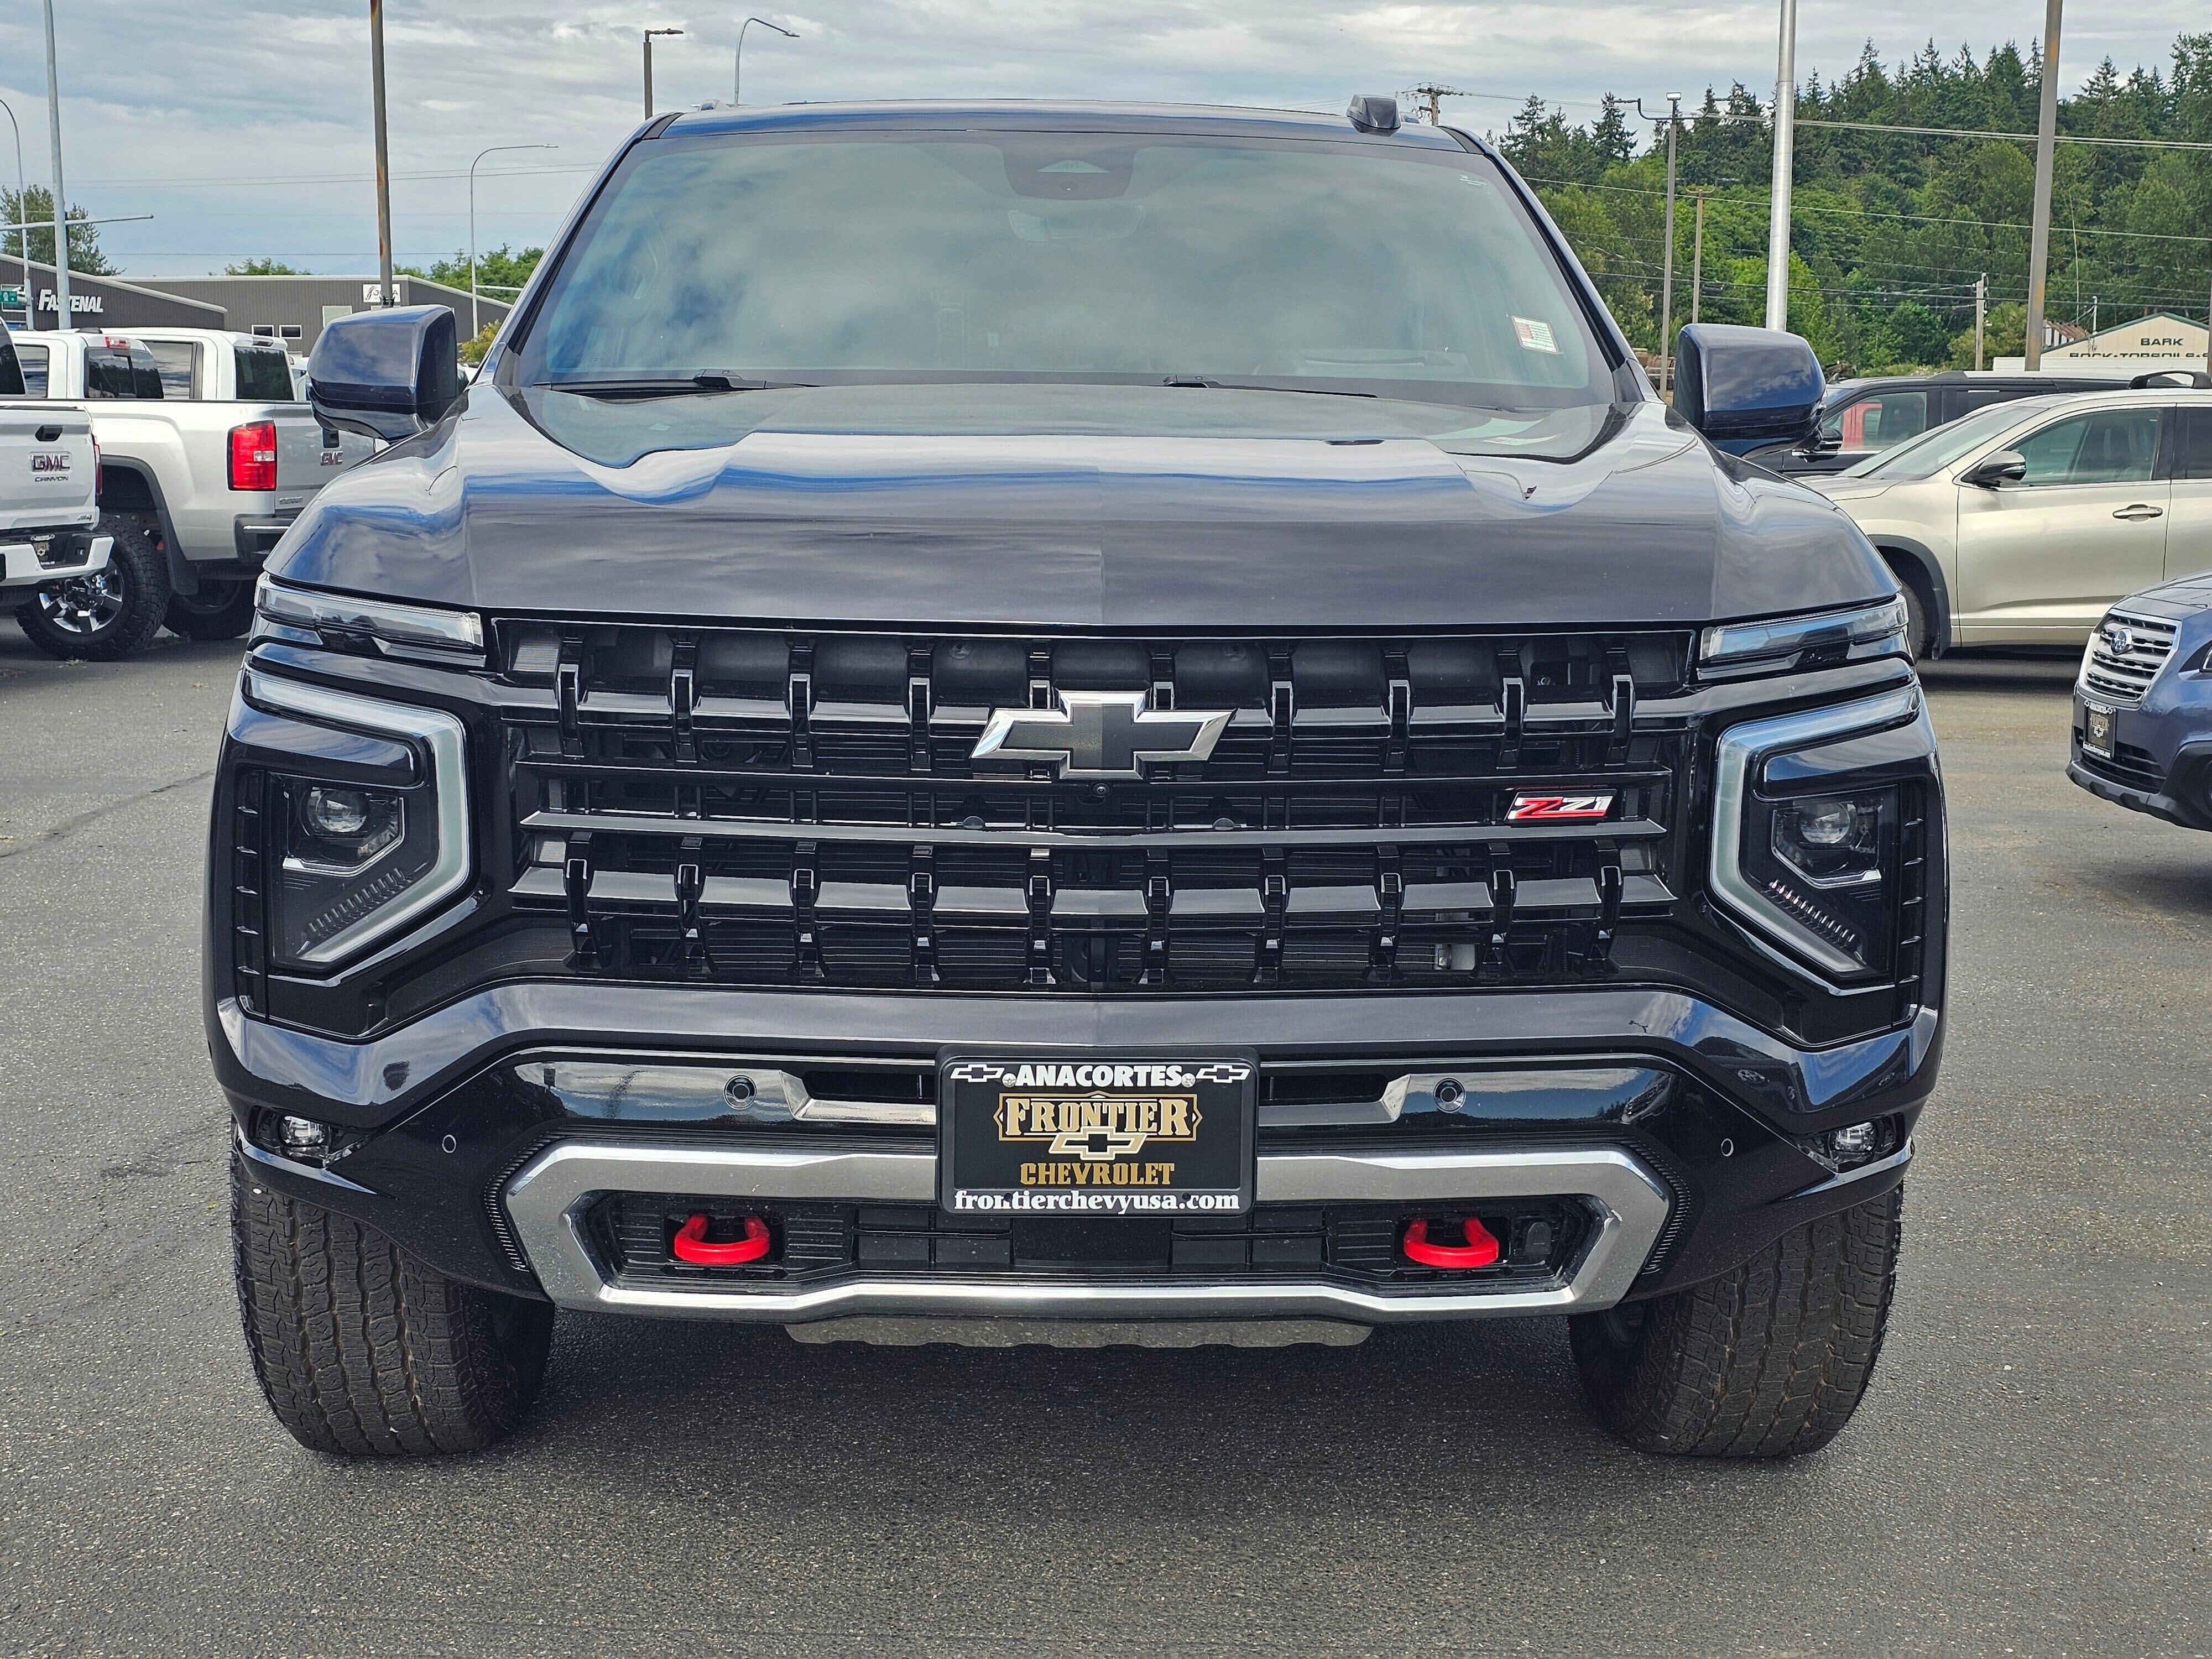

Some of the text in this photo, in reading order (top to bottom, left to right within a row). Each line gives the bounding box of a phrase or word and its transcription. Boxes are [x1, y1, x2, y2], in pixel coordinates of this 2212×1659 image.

[38, 289, 103, 312] FAENAL
[31, 454, 70, 472] GMC
[1507, 796, 1613, 820] Z71
[1015, 1065, 1182, 1087] ANACORTES
[1005, 1098, 1191, 1135] FRONTIER
[1020, 1163, 1175, 1185] CHEVROLET
[954, 1190, 1240, 1215] frontierchevyusa.com
